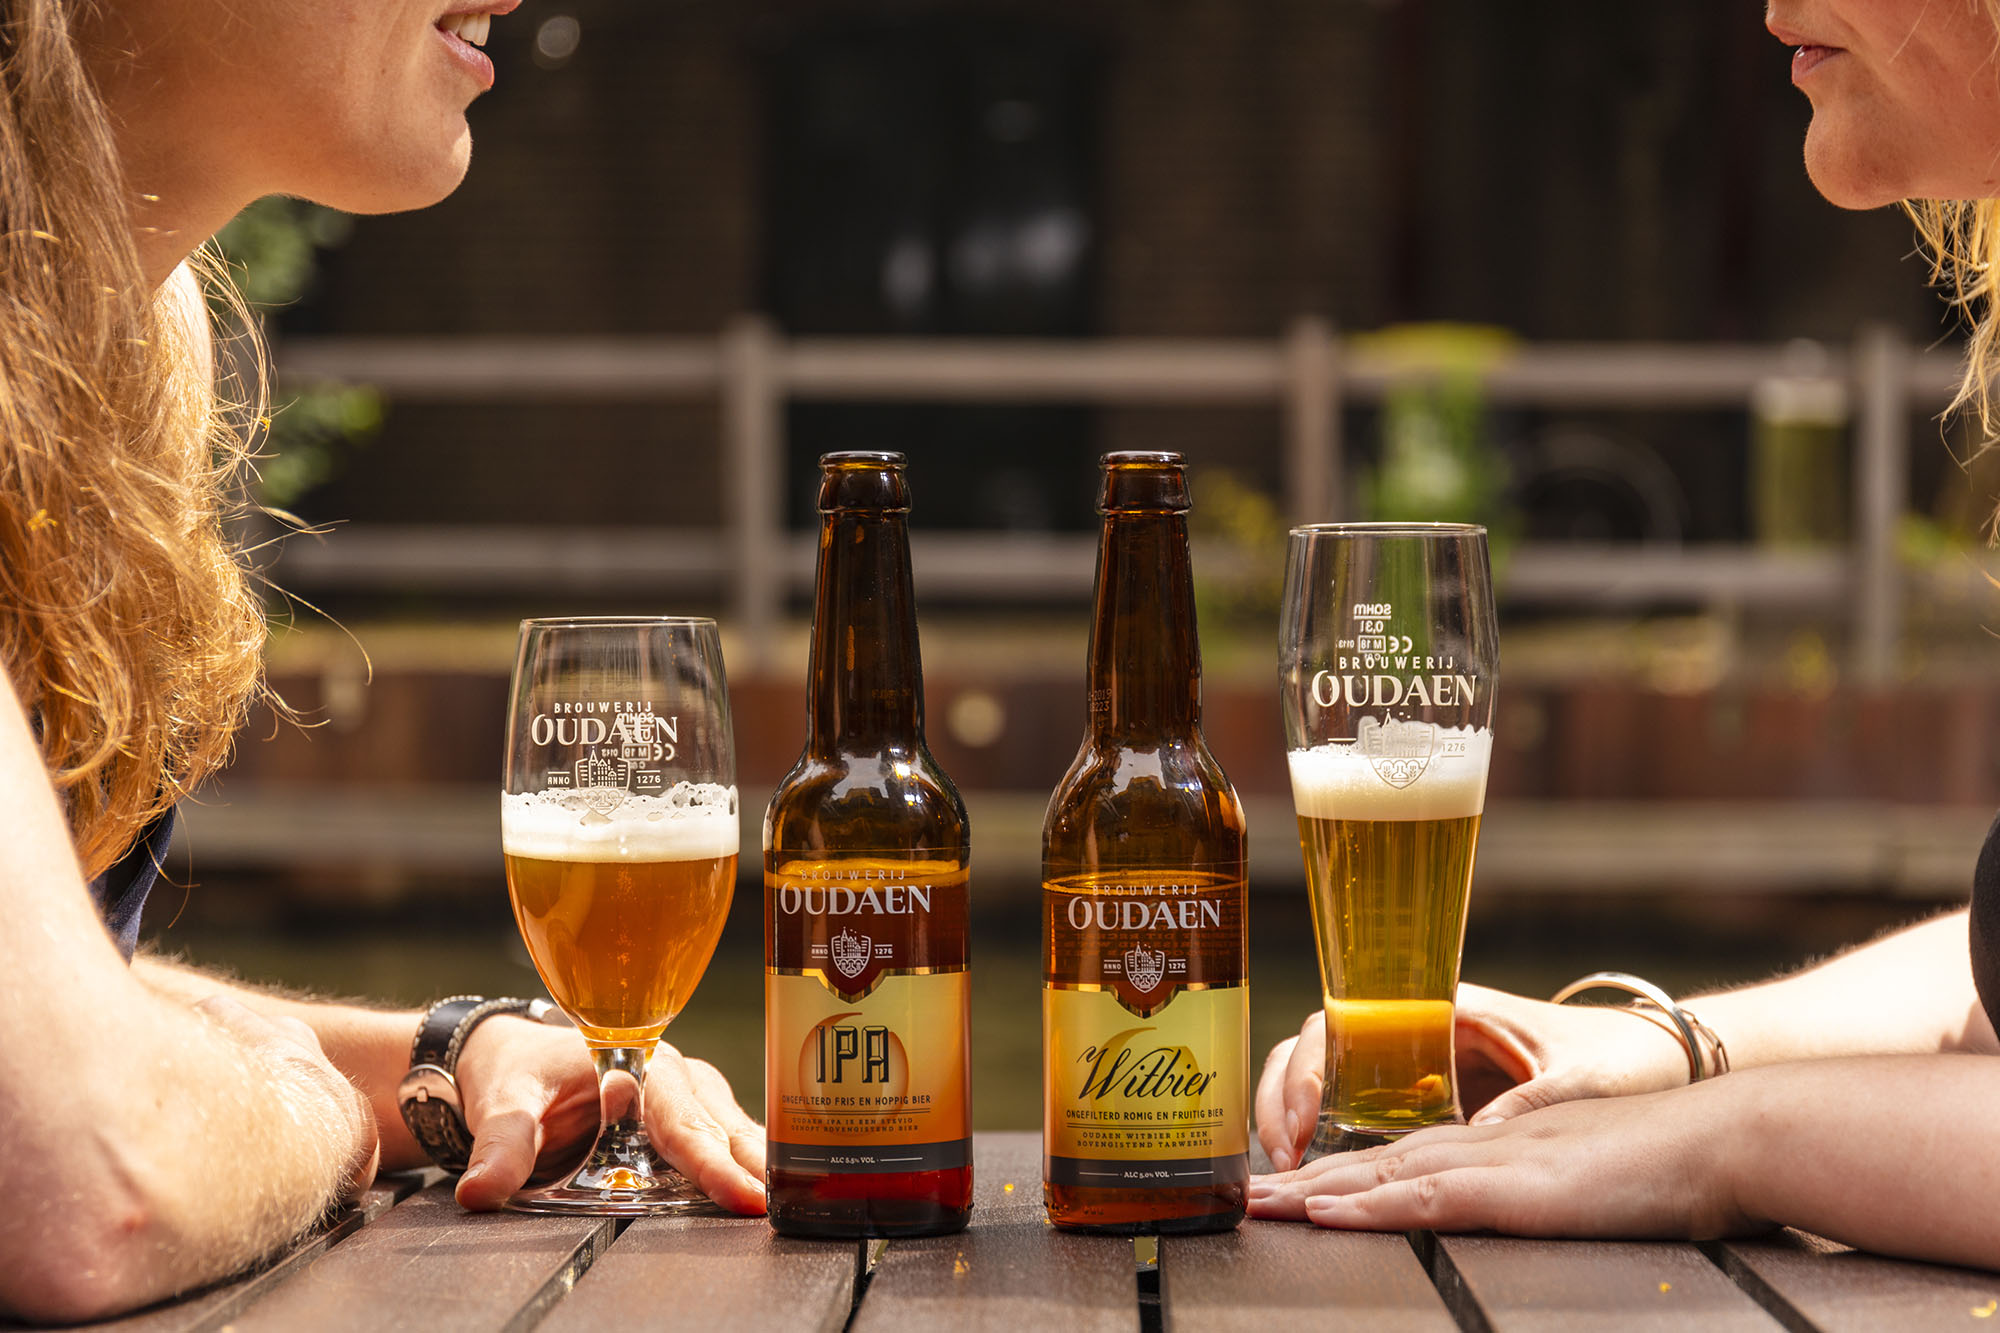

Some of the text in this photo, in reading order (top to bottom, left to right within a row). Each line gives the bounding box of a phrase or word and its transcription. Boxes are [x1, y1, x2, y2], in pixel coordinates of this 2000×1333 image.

[1339, 656, 1453, 670] BROUWERIJ
[1312, 670, 1477, 707] OUDAEN
[554, 701, 652, 714] BROUWERIJ
[531, 713, 678, 746] OUDAEN
[1442, 742, 1466, 752] 1276
[547, 775, 661, 785] ANNO 1276
[801, 869, 905, 881] BROUWERIJ
[1092, 884, 1198, 896] BROUWERIJ
[780, 881, 932, 915] OUDAEN
[1067, 896, 1221, 930] OUDAEN
[874, 947, 893, 955] 1276
[1168, 962, 1186, 970] 1276
[816, 1025, 889, 1083] IPA
[1077, 1045, 1217, 1100] Witbier
[835, 1096, 855, 1106] FRIS
[859, 1097, 871, 1106] EN
[875, 1096, 909, 1106] HOPPIG
[912, 1095, 931, 1104] BIER
[1066, 1108, 1224, 1121] ONGEFILTERD ROMIG EN FRUITIG BIER
[1082, 1131, 1121, 1139] OUDAEN
[1176, 1131, 1186, 1139] IS
[1190, 1130, 1208, 1138] EEN
[830, 1156, 845, 1164] ALC
[860, 1156, 876, 1164] VOL
[1154, 1170, 1170, 1178] VOL
